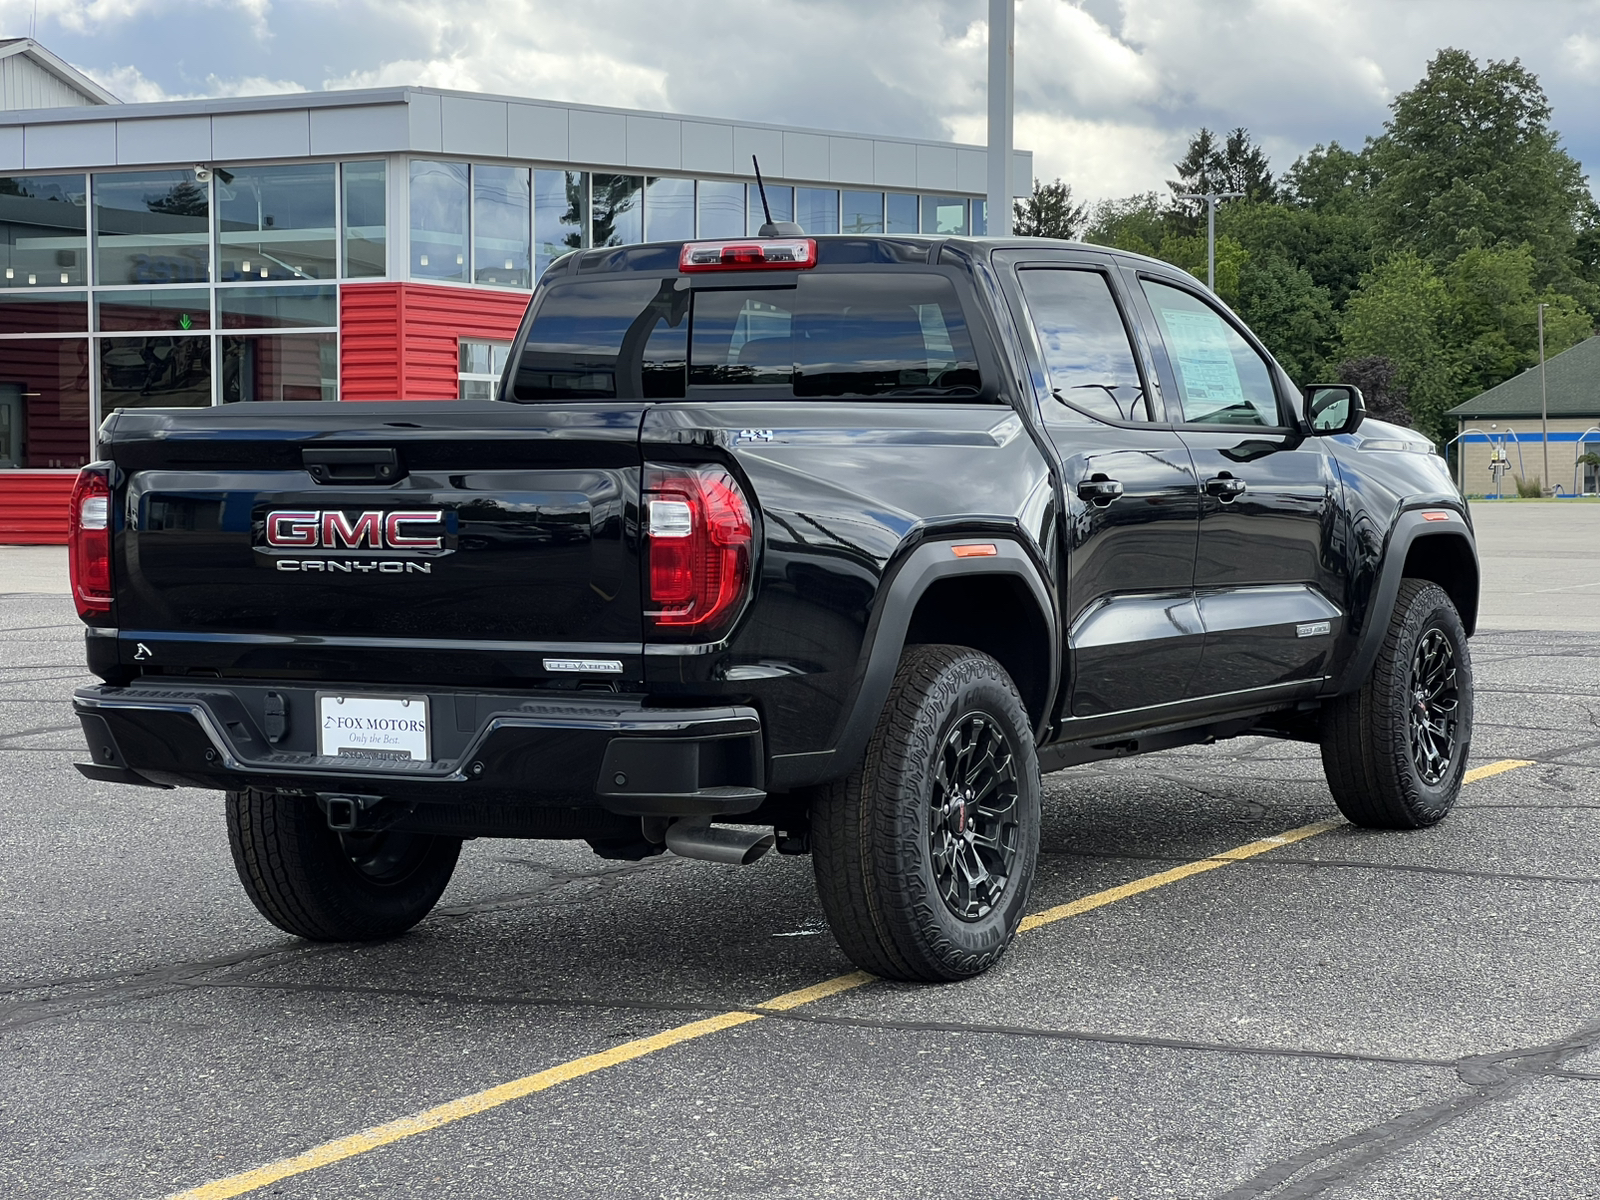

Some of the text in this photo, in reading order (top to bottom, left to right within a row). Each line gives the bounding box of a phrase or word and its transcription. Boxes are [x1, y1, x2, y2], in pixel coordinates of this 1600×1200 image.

[266, 509, 443, 549] GMC
[276, 559, 432, 574] CANYON
[337, 716, 425, 732] FOX MOTORS
[349, 732, 368, 746] Only
[369, 733, 381, 744] the
